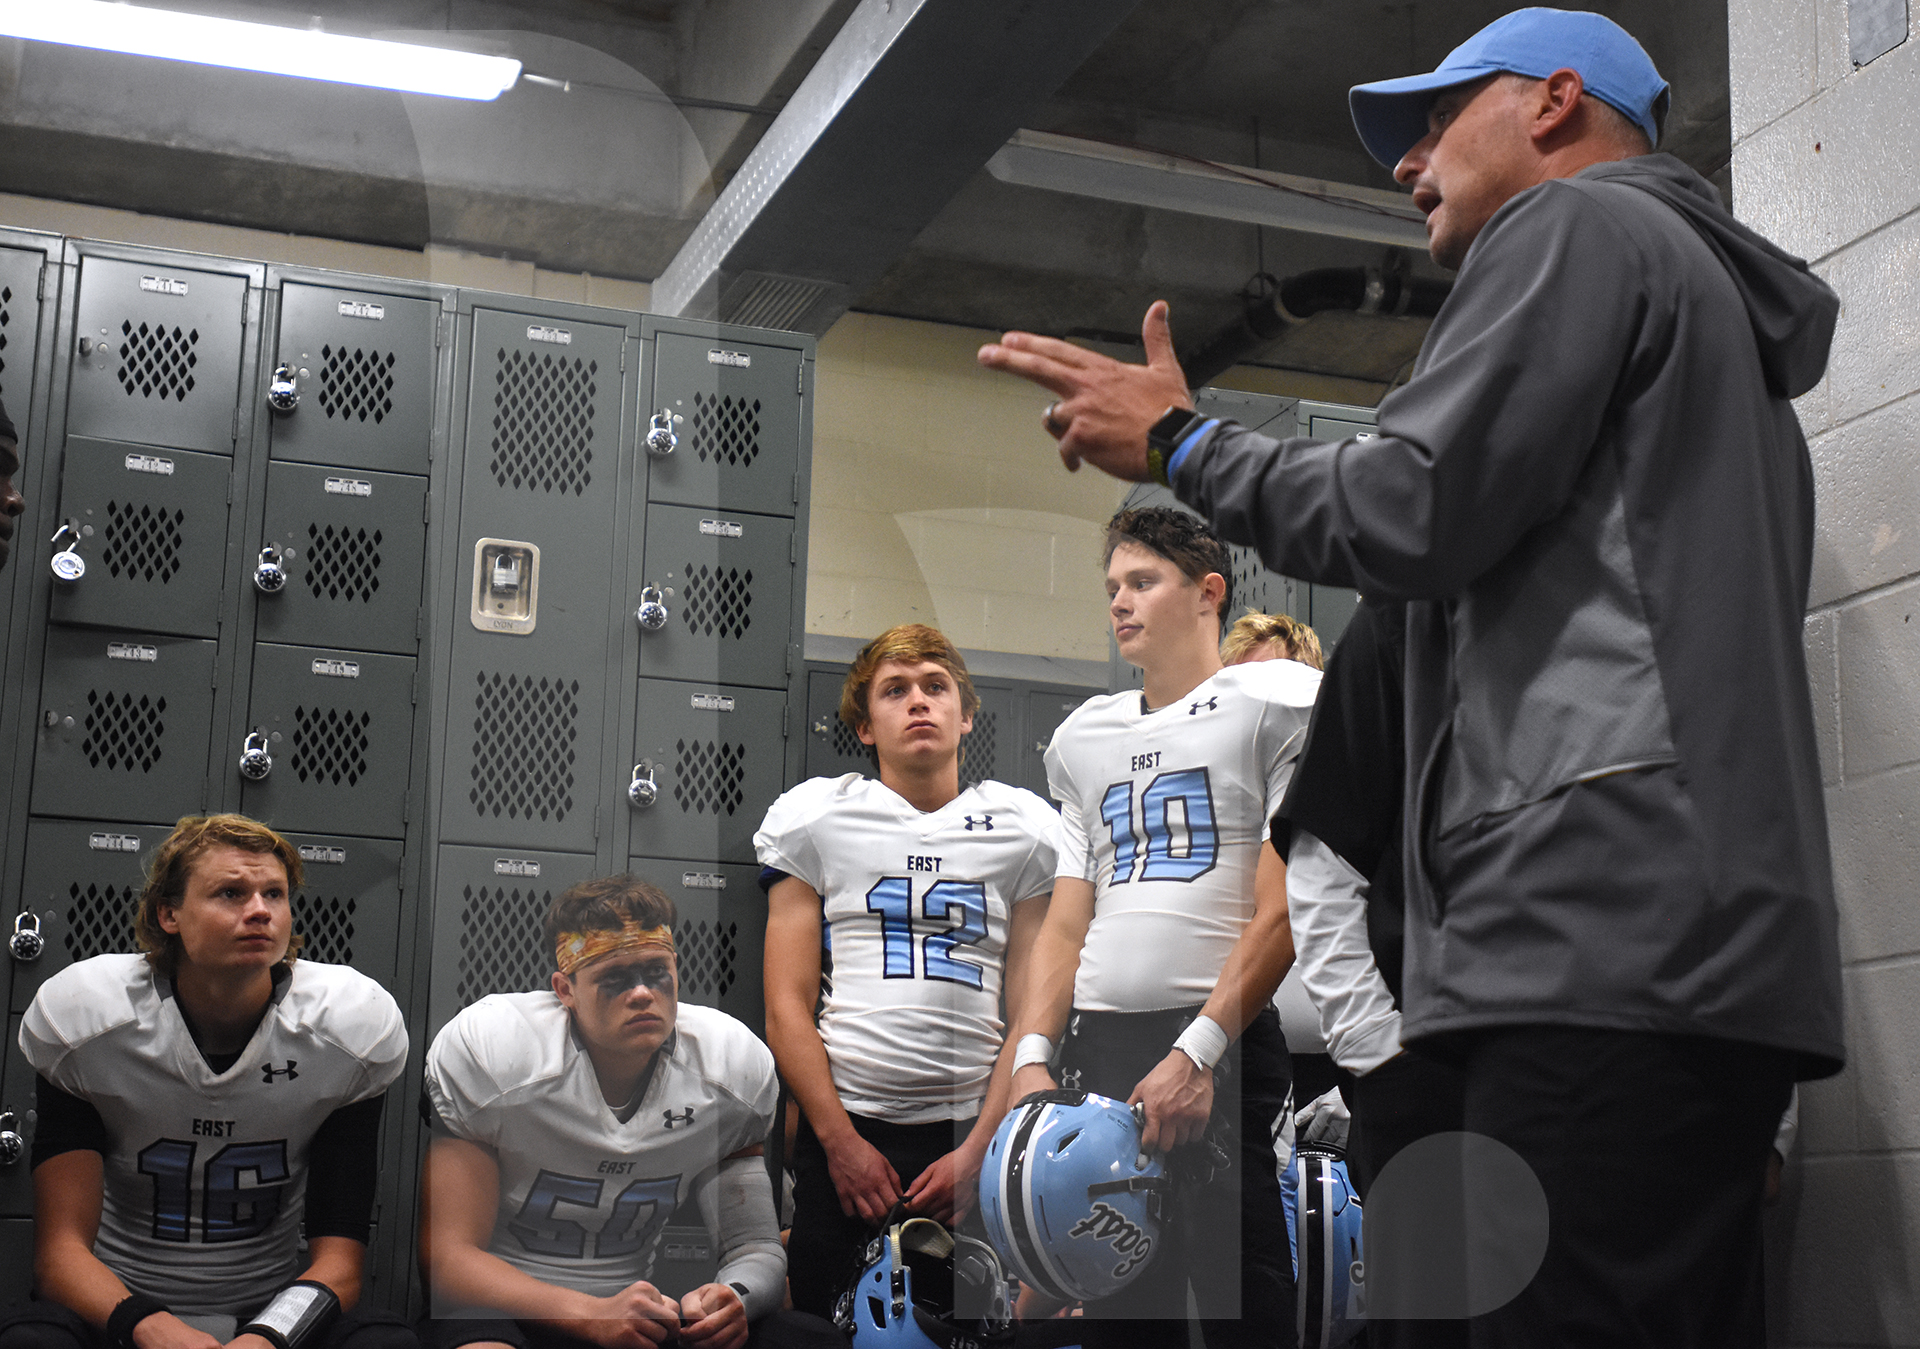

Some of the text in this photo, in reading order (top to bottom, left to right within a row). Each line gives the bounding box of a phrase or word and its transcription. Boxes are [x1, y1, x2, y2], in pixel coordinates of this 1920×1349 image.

[1131, 751, 1162, 772] EAST
[907, 855, 942, 872] EAST
[1099, 766, 1220, 888] 10
[865, 875, 989, 992] 12
[192, 1118, 236, 1137] EAST
[137, 1137, 290, 1244] 16
[597, 1160, 637, 1175] EAST
[507, 1168, 683, 1259] 50
[1067, 1201, 1154, 1280] East
